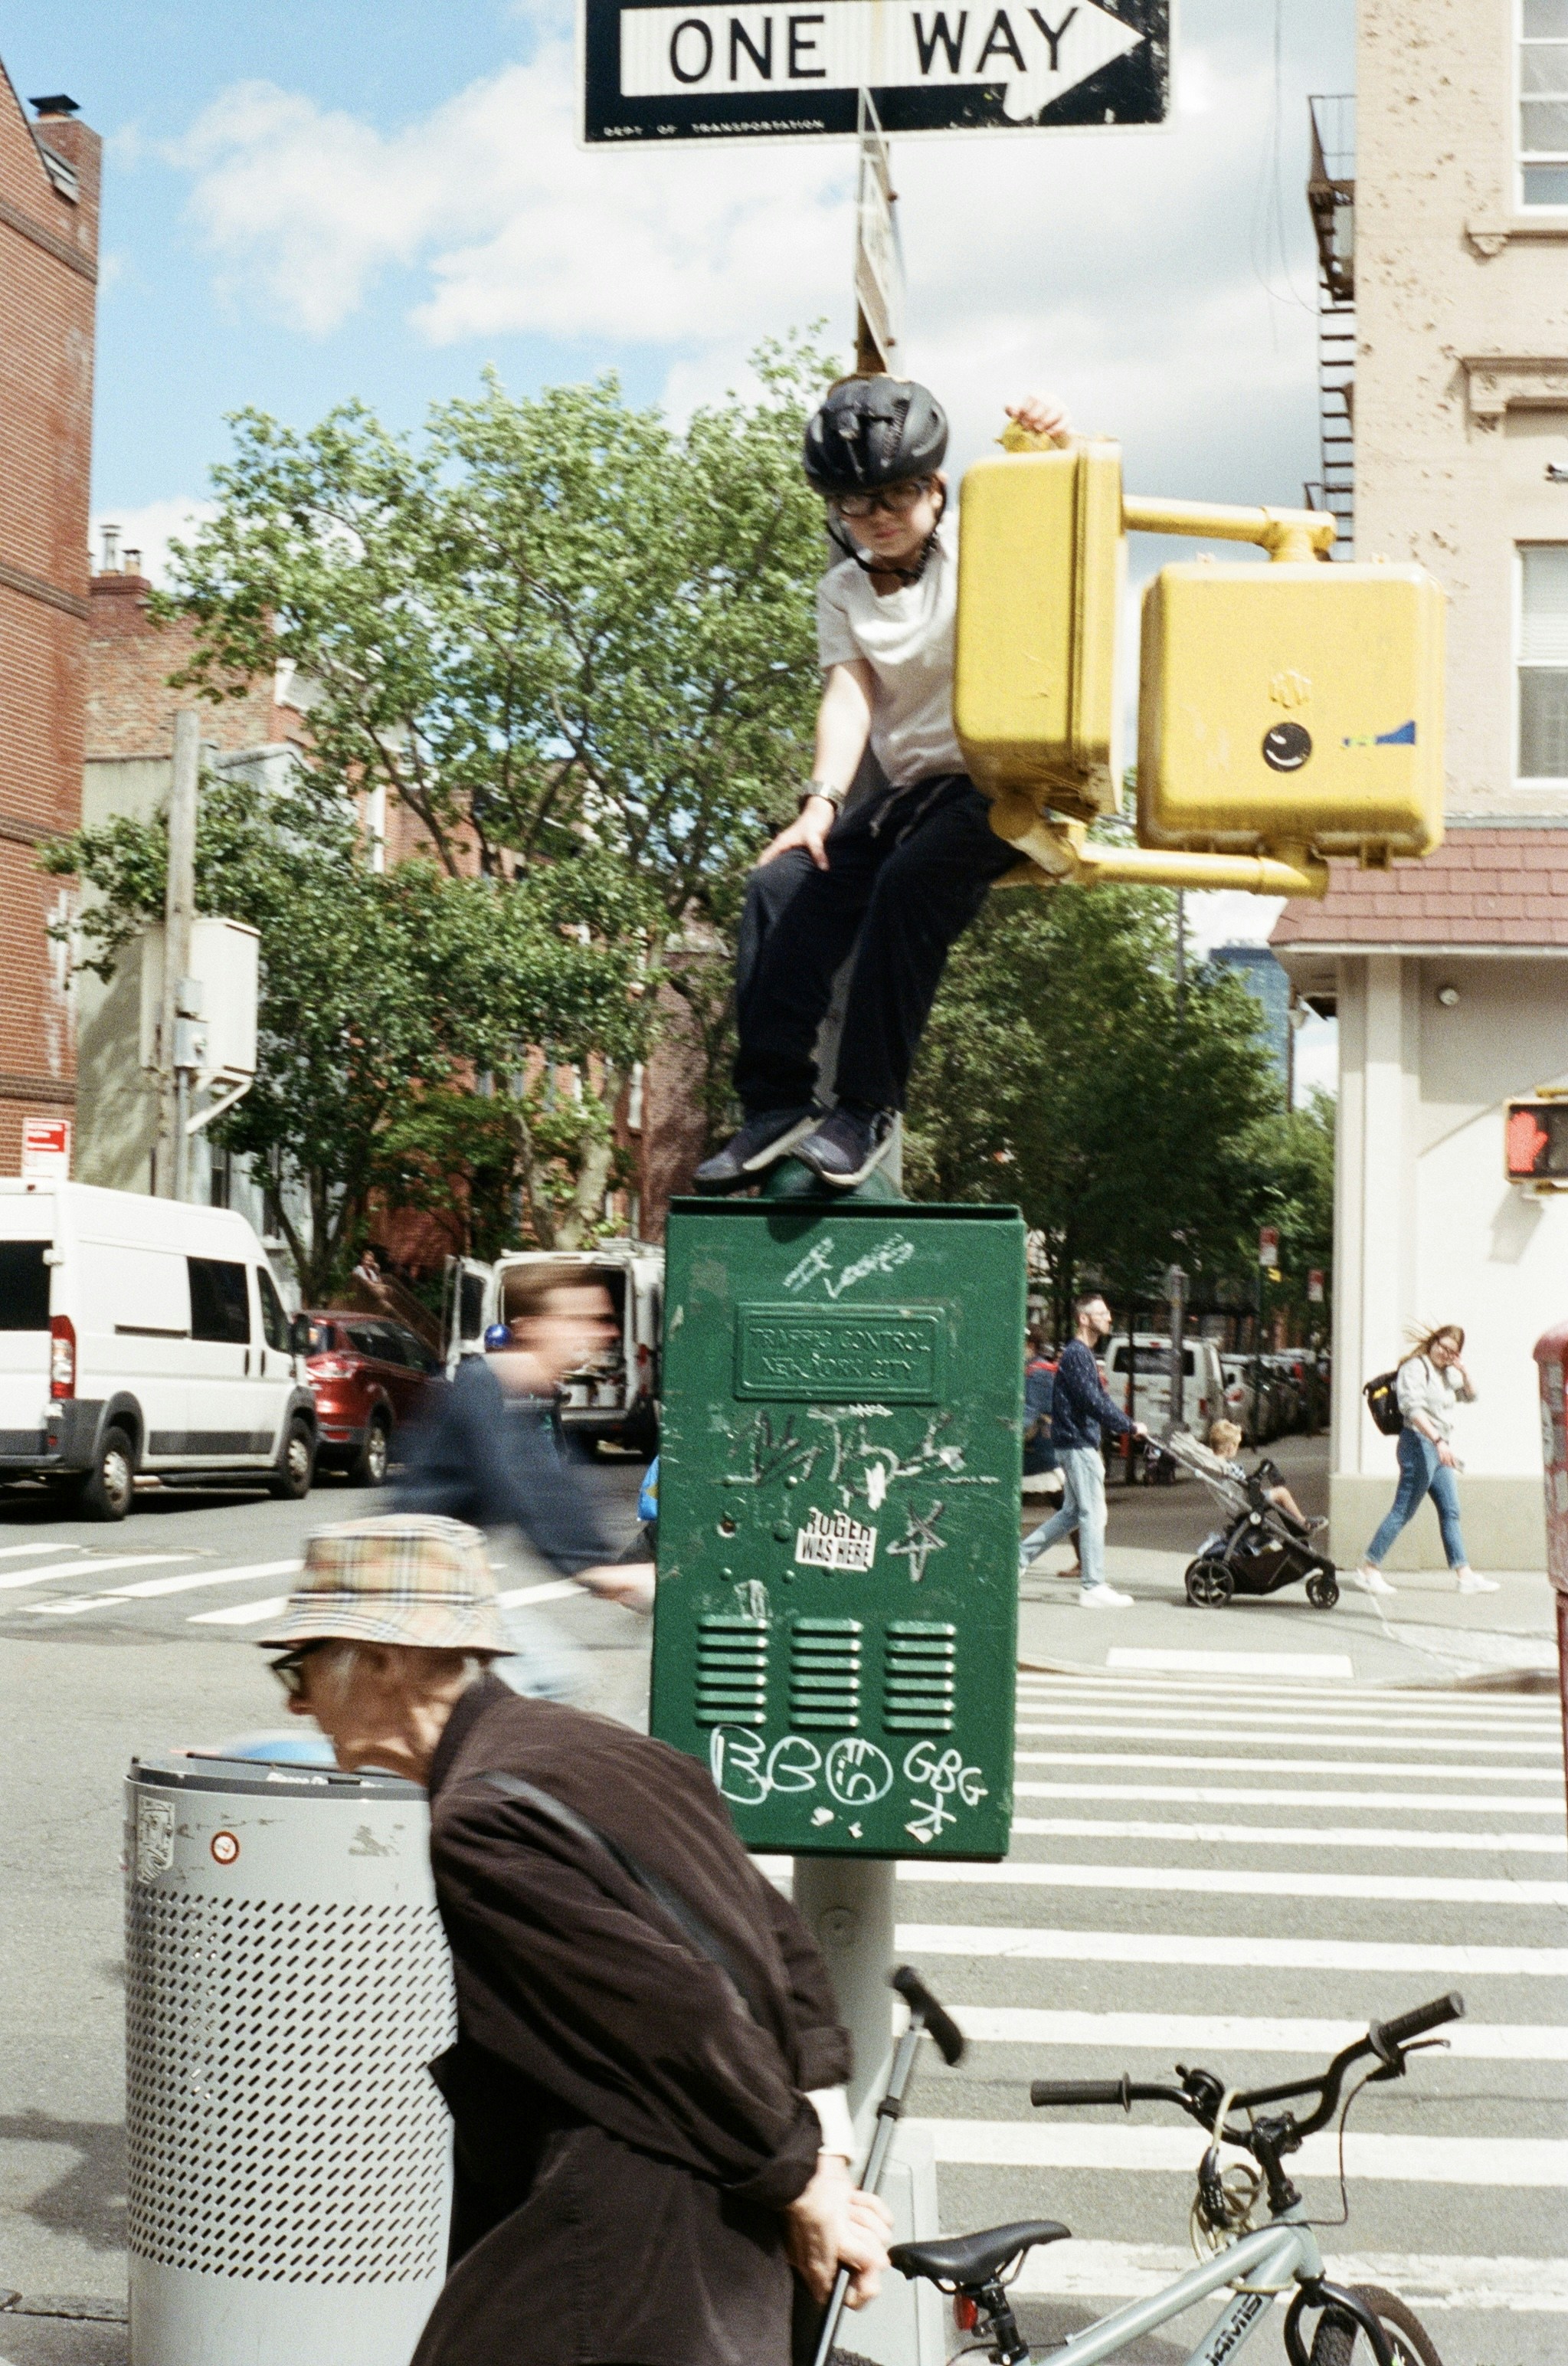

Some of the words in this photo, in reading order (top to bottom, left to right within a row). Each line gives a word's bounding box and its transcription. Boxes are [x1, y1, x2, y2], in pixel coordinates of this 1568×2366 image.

[669, 15, 827, 84] ONE
[912, 7, 1078, 75] WAY
[656, 123, 678, 135] OF
[691, 119, 825, 133] TRANSPORTATION
[749, 1327, 833, 1348] TRAFFIC
[841, 1329, 931, 1352] CONTROL
[761, 1355, 810, 1378] NEW
[810, 1356, 863, 1378] YORK
[870, 1358, 919, 1378] CITY
